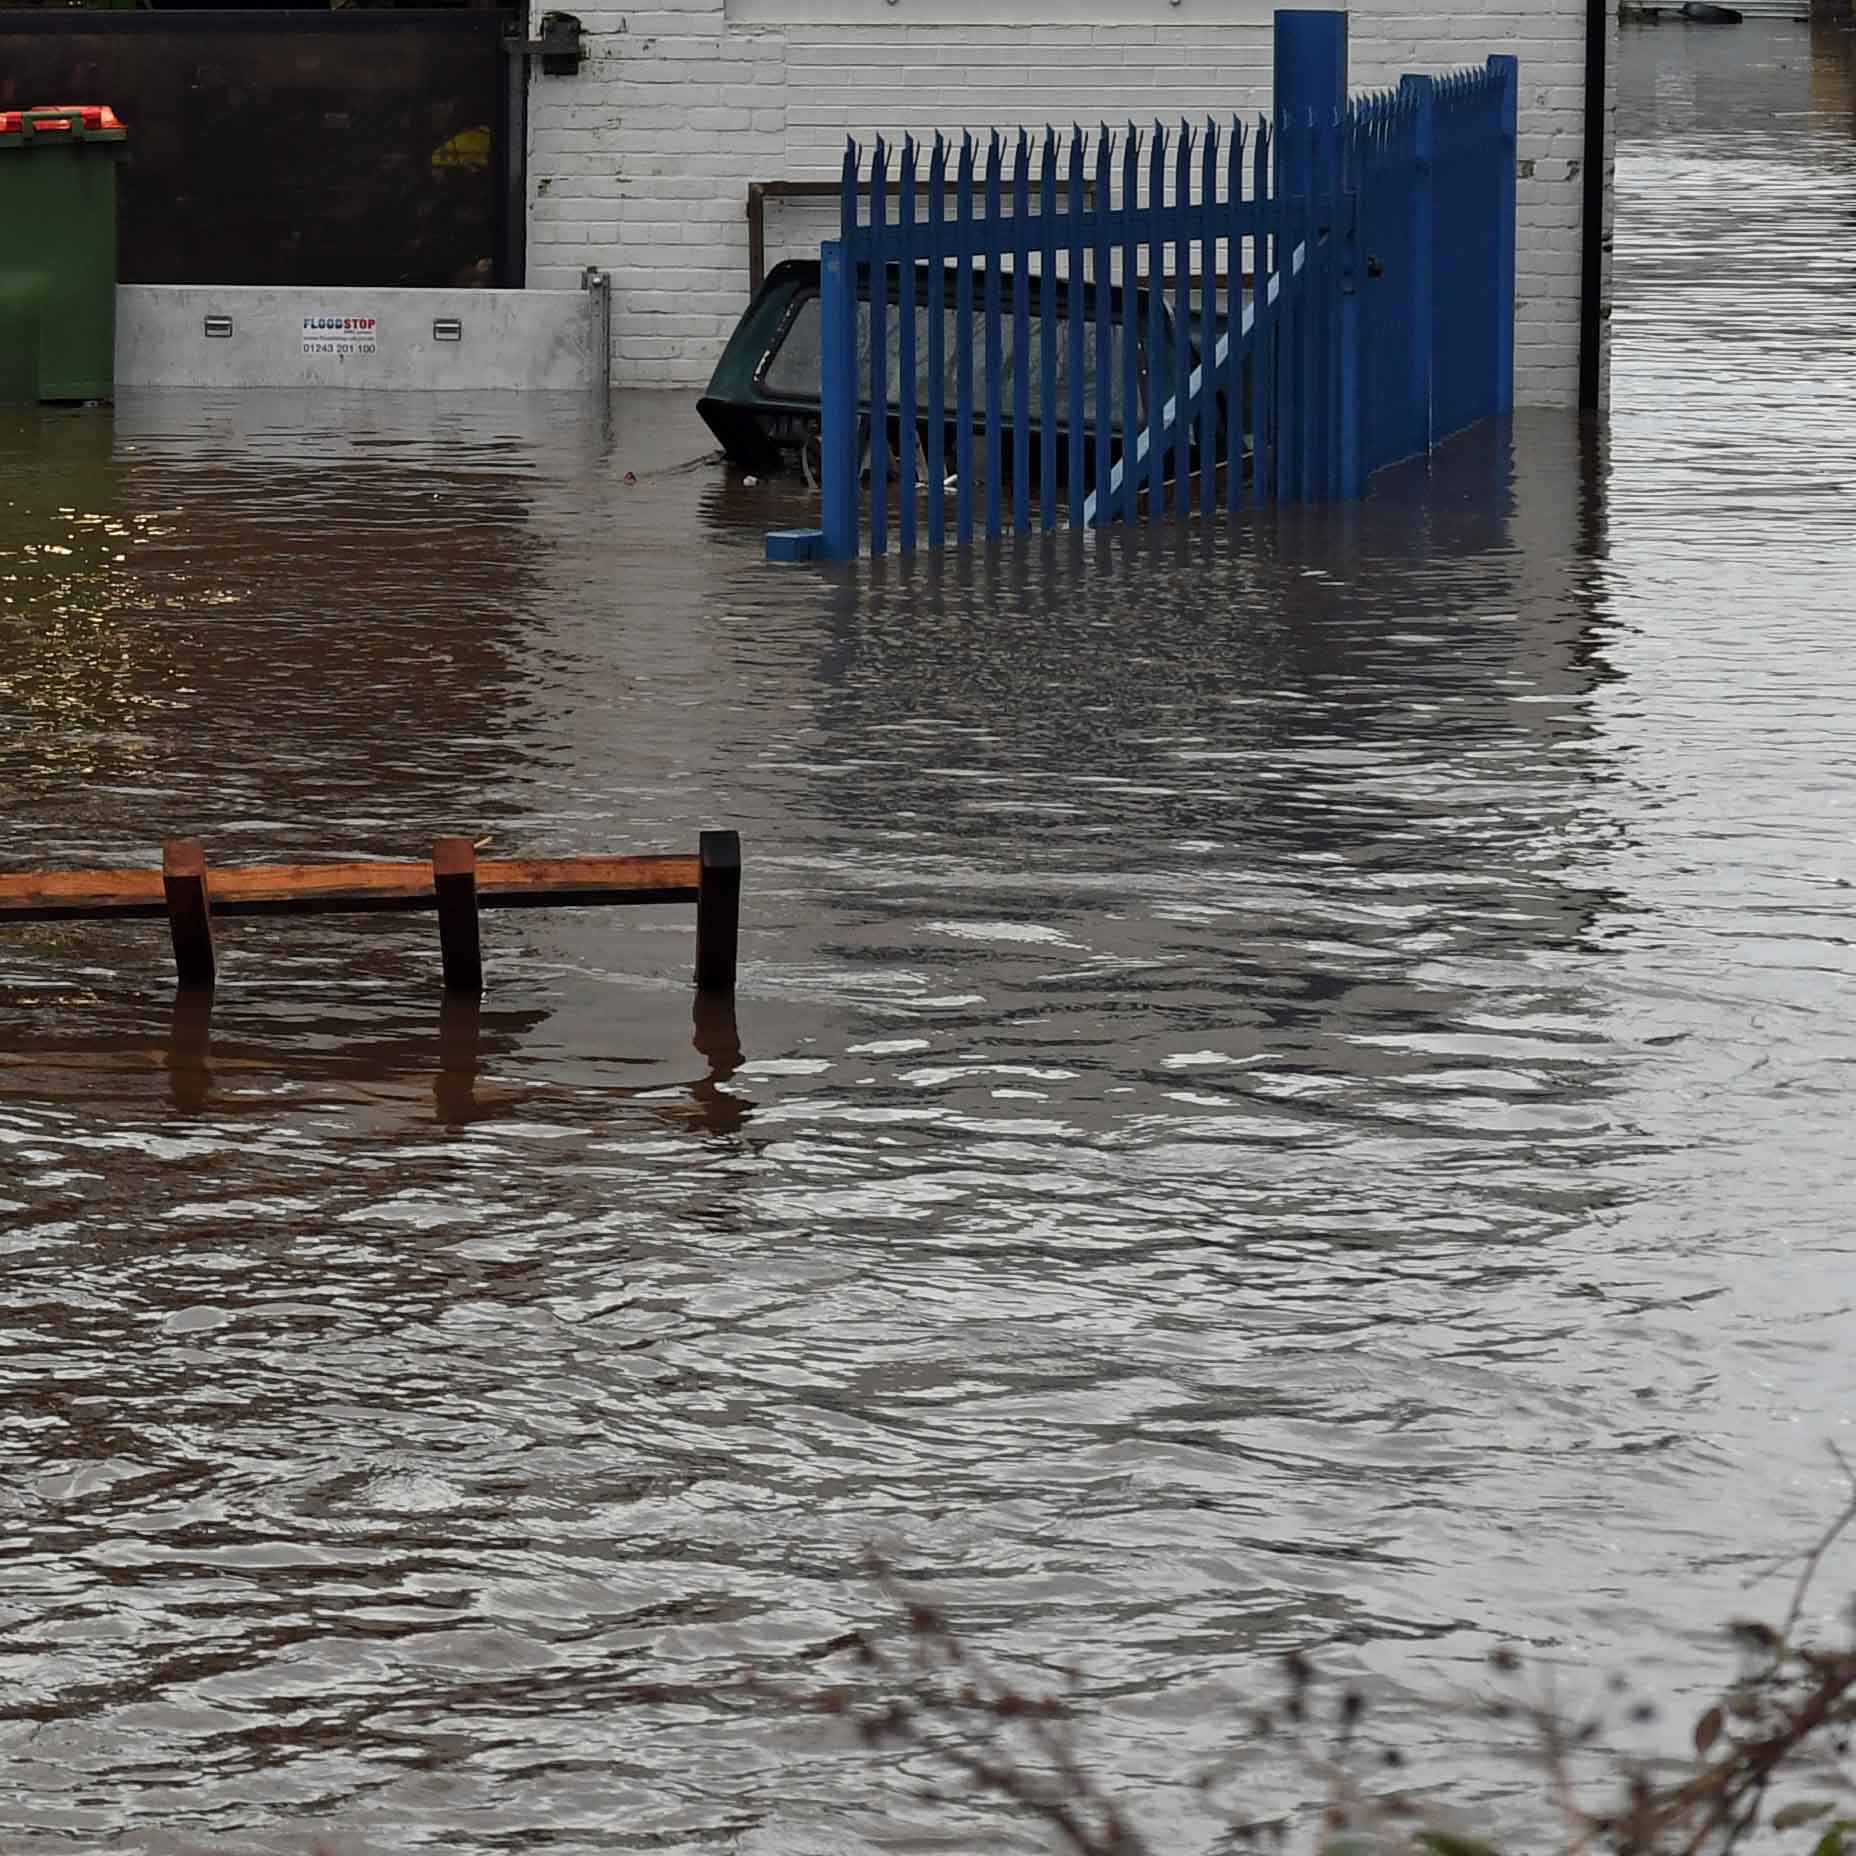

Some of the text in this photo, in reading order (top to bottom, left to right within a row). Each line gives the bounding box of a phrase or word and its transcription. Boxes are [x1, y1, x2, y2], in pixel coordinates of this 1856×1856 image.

[303, 343, 376, 353] 01243 201 100
